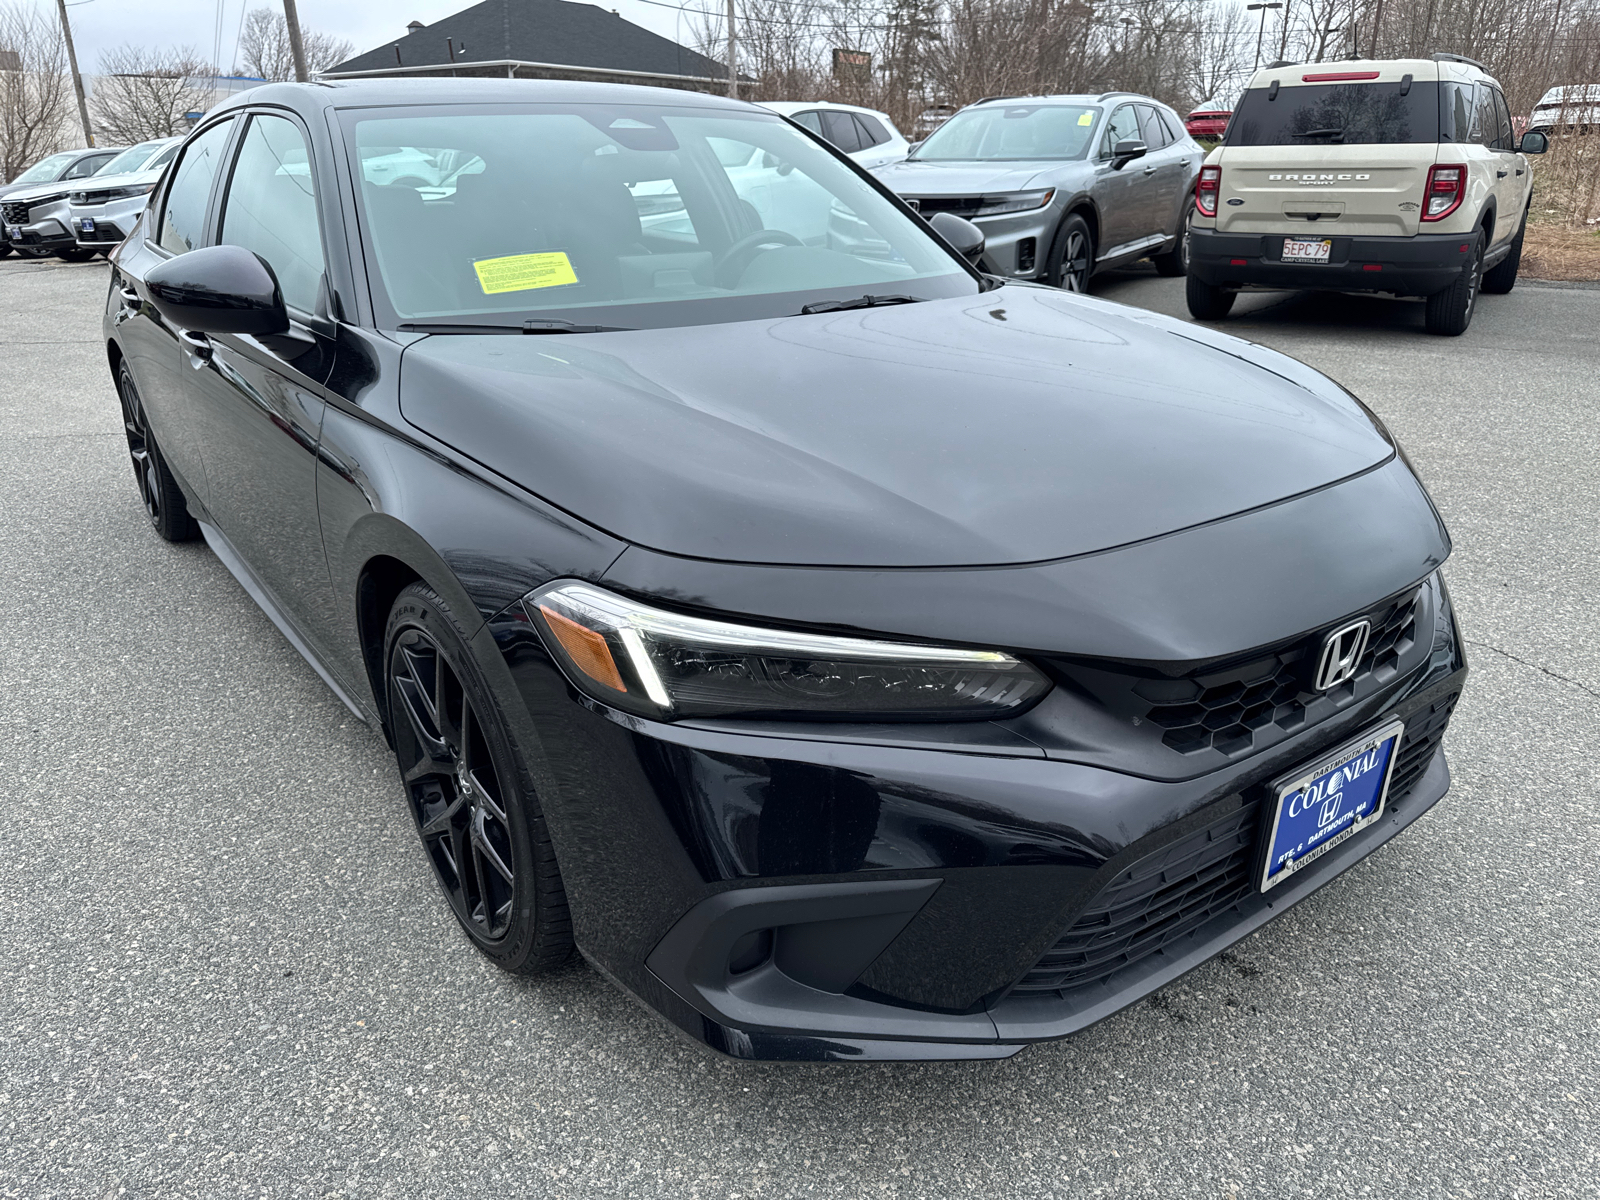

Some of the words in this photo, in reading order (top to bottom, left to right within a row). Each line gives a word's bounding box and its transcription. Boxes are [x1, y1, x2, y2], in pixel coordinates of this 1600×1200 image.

[1283, 242, 1312, 256] 5EPC
[1314, 243, 1329, 257] 79
[1289, 751, 1380, 818] COLONIAL
[1277, 848, 1296, 865] RTE.
[1297, 842, 1303, 852] 6
[1355, 801, 1367, 814] MA
[1292, 844, 1328, 873] COLONIAL
[1328, 827, 1354, 849] HONDA
